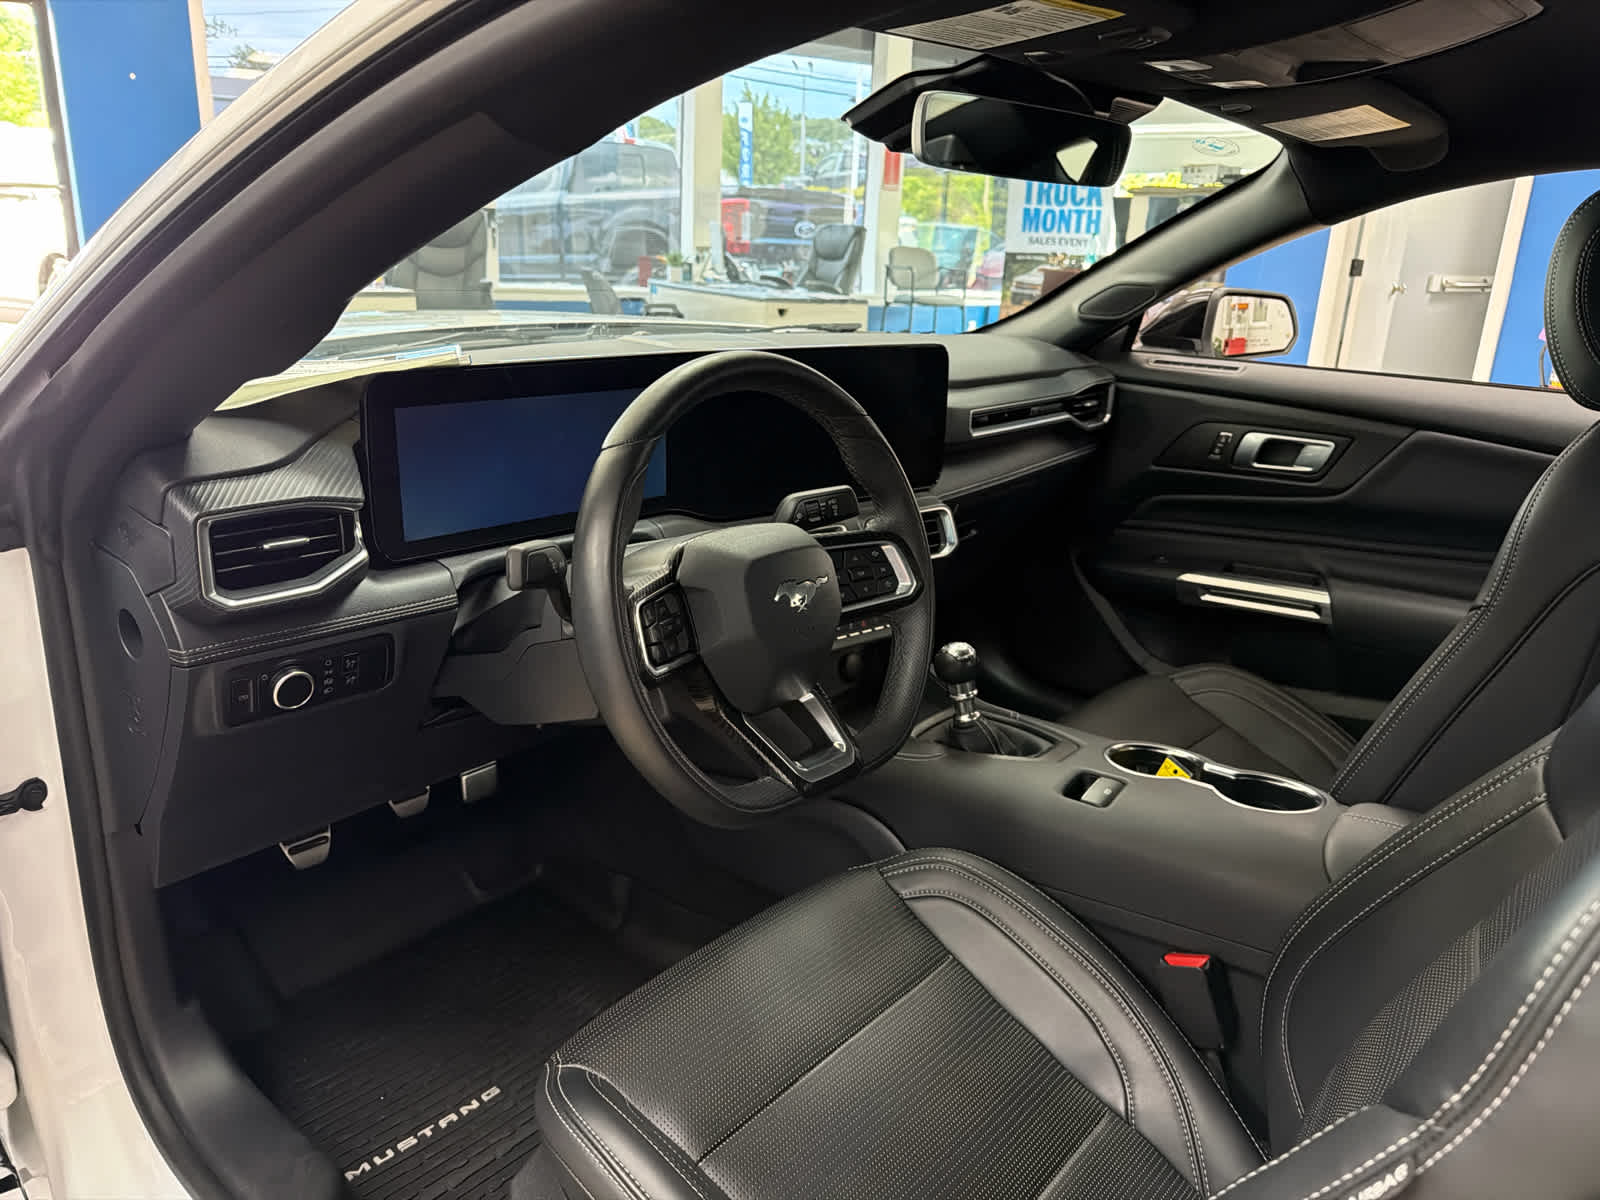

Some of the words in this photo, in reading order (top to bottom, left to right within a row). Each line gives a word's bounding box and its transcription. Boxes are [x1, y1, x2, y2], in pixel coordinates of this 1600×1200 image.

[1025, 181, 1102, 206] TRUCK
[1022, 208, 1102, 234] MONTH
[1028, 236, 1057, 247] SALES
[1059, 238, 1088, 248] EVENT
[345, 1086, 501, 1181] MUSTANG
